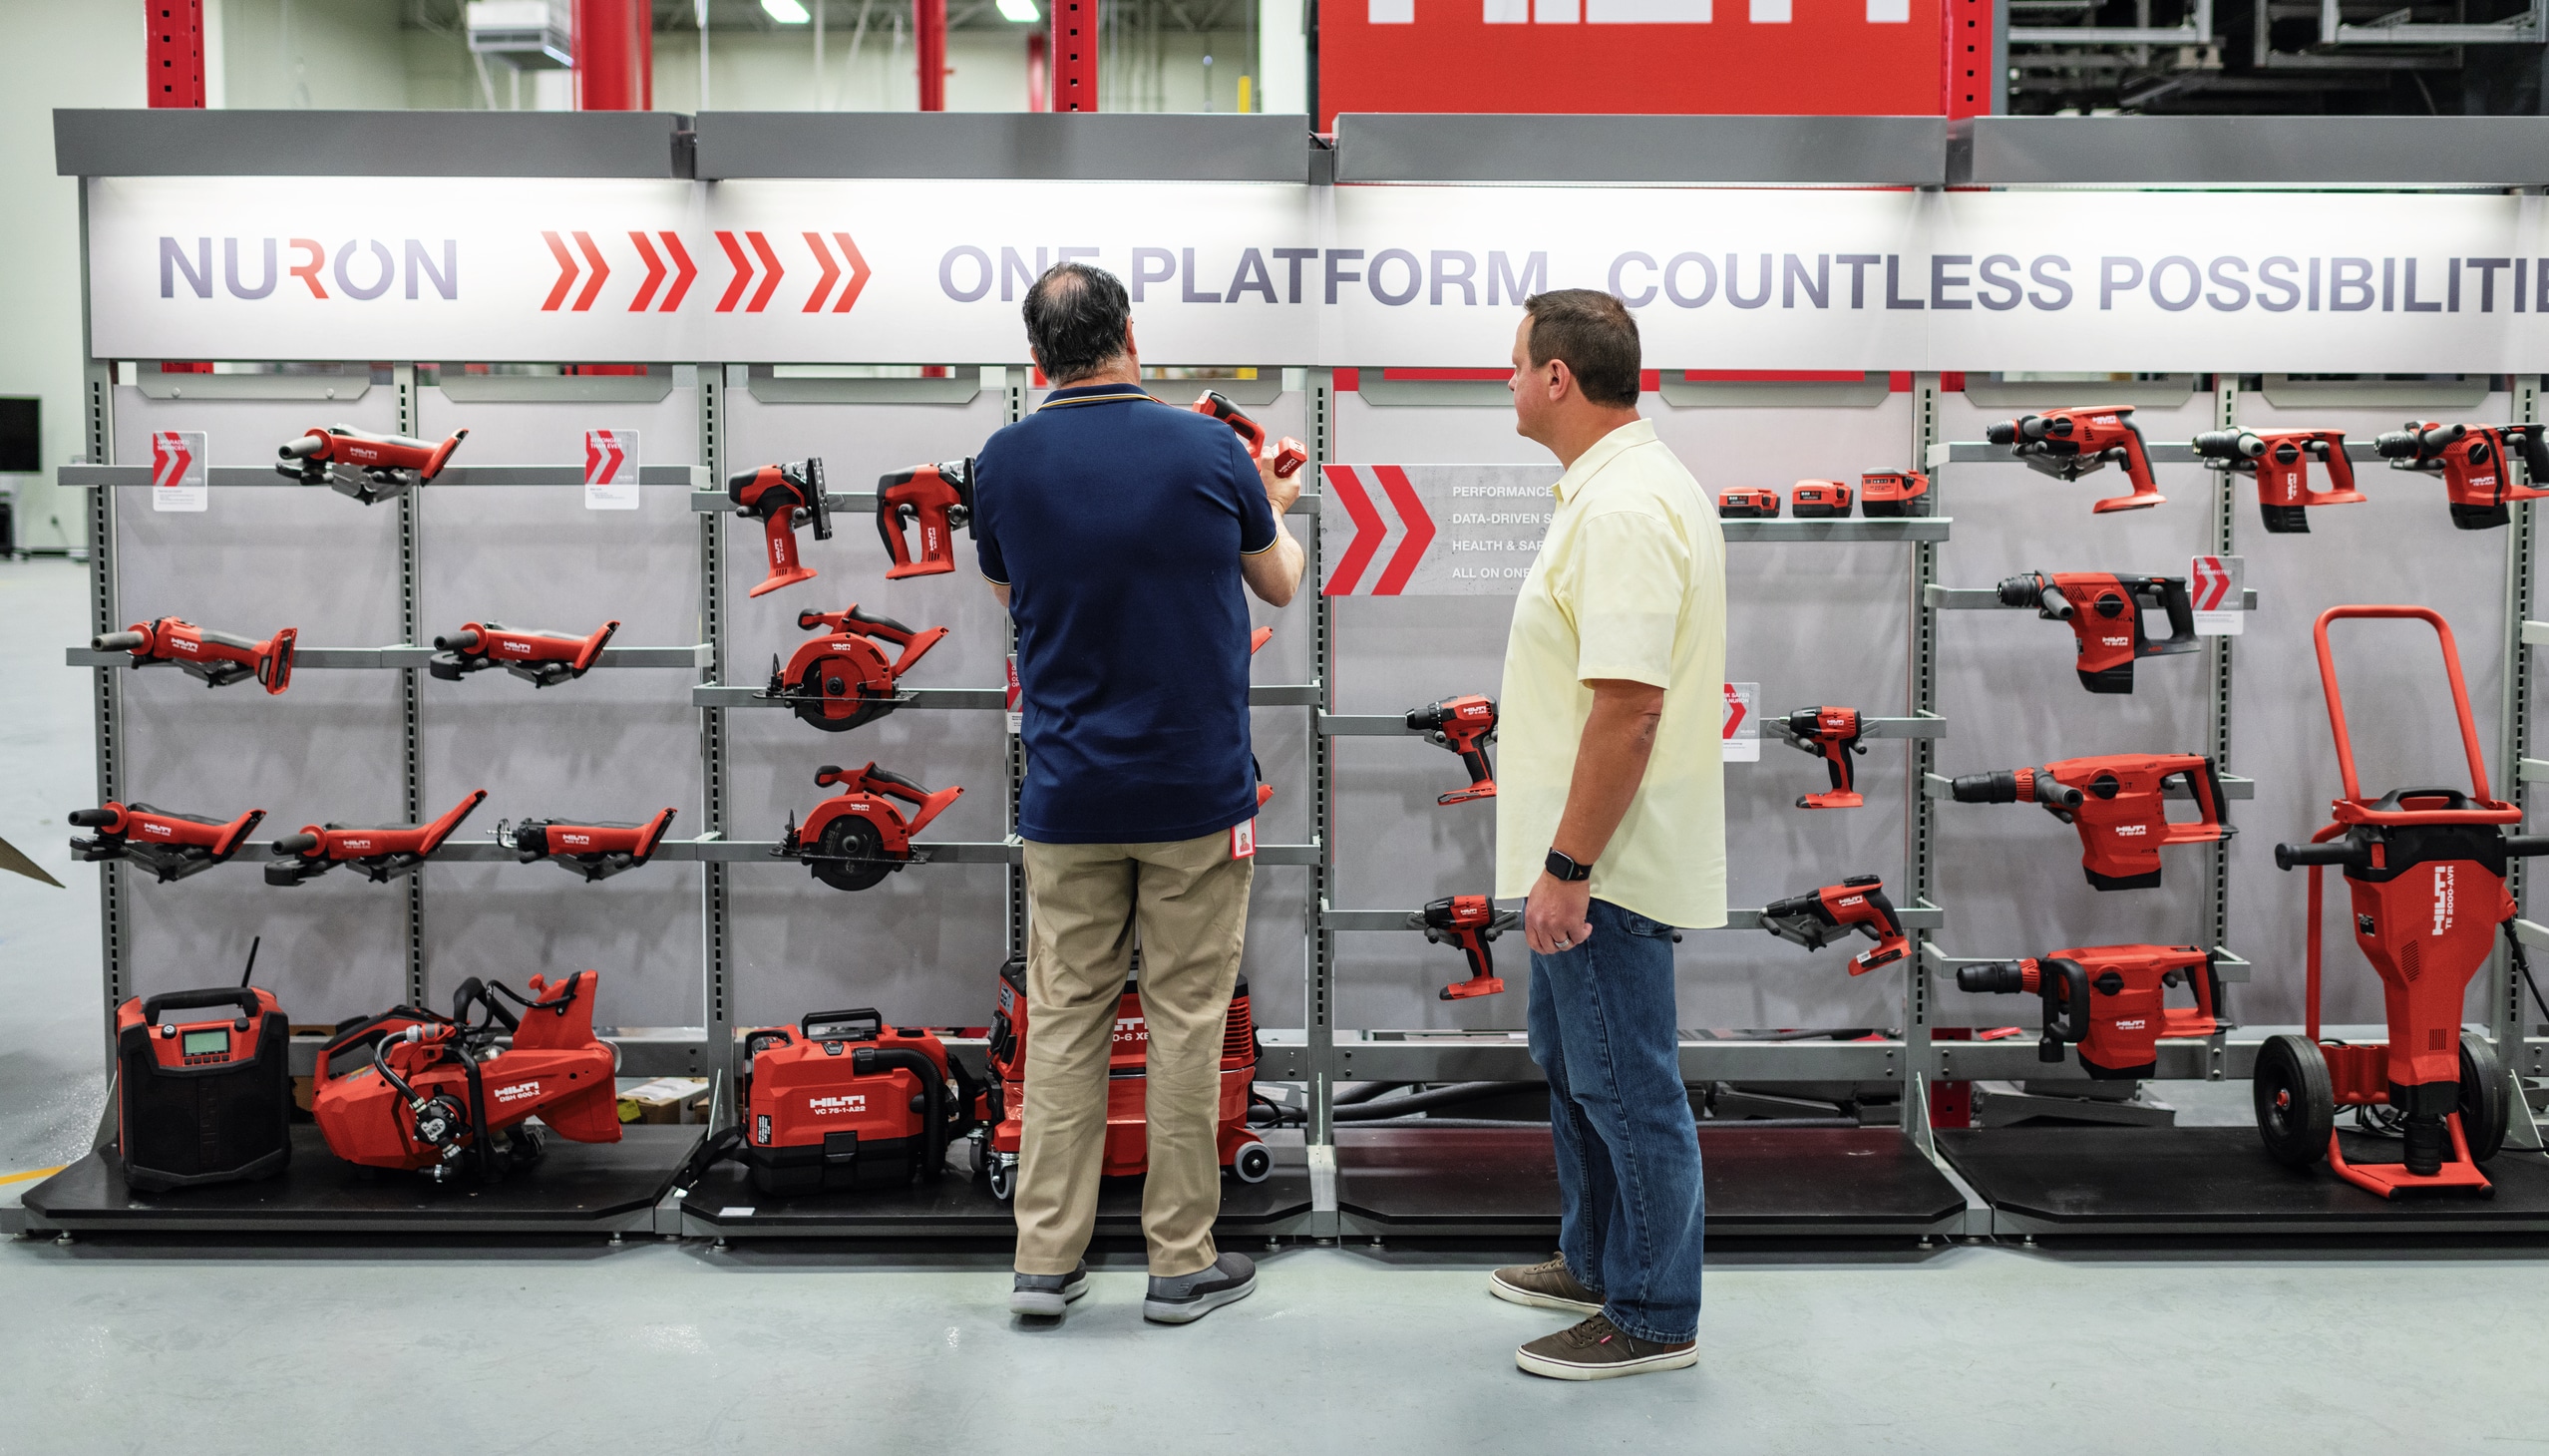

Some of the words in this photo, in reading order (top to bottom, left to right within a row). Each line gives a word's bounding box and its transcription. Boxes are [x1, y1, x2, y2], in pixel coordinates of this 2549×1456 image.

[160, 236, 459, 300] NURON
[938, 245, 1100, 302] ON
[1132, 246, 1548, 306] PLATFORM
[1608, 250, 2072, 311] COUNTLESS
[1452, 486, 1554, 498] PERFORMANCE
[1452, 514, 1540, 525] DATA-DRIVEN
[1452, 541, 1503, 551] HEALTH
[1506, 541, 1516, 551] &
[1452, 567, 1477, 578] ALL
[1480, 567, 1499, 578] ON
[172, 637, 198, 649] HILTI
[504, 641, 531, 650] HILTI
[145, 823, 172, 834] HILTI
[1838, 896, 1864, 905] HILTI
[2432, 866, 2446, 935] HILTI
[2445, 916, 2453, 929] TE
[494, 1081, 540, 1098] HILTI
[810, 1095, 866, 1108] HILTI
